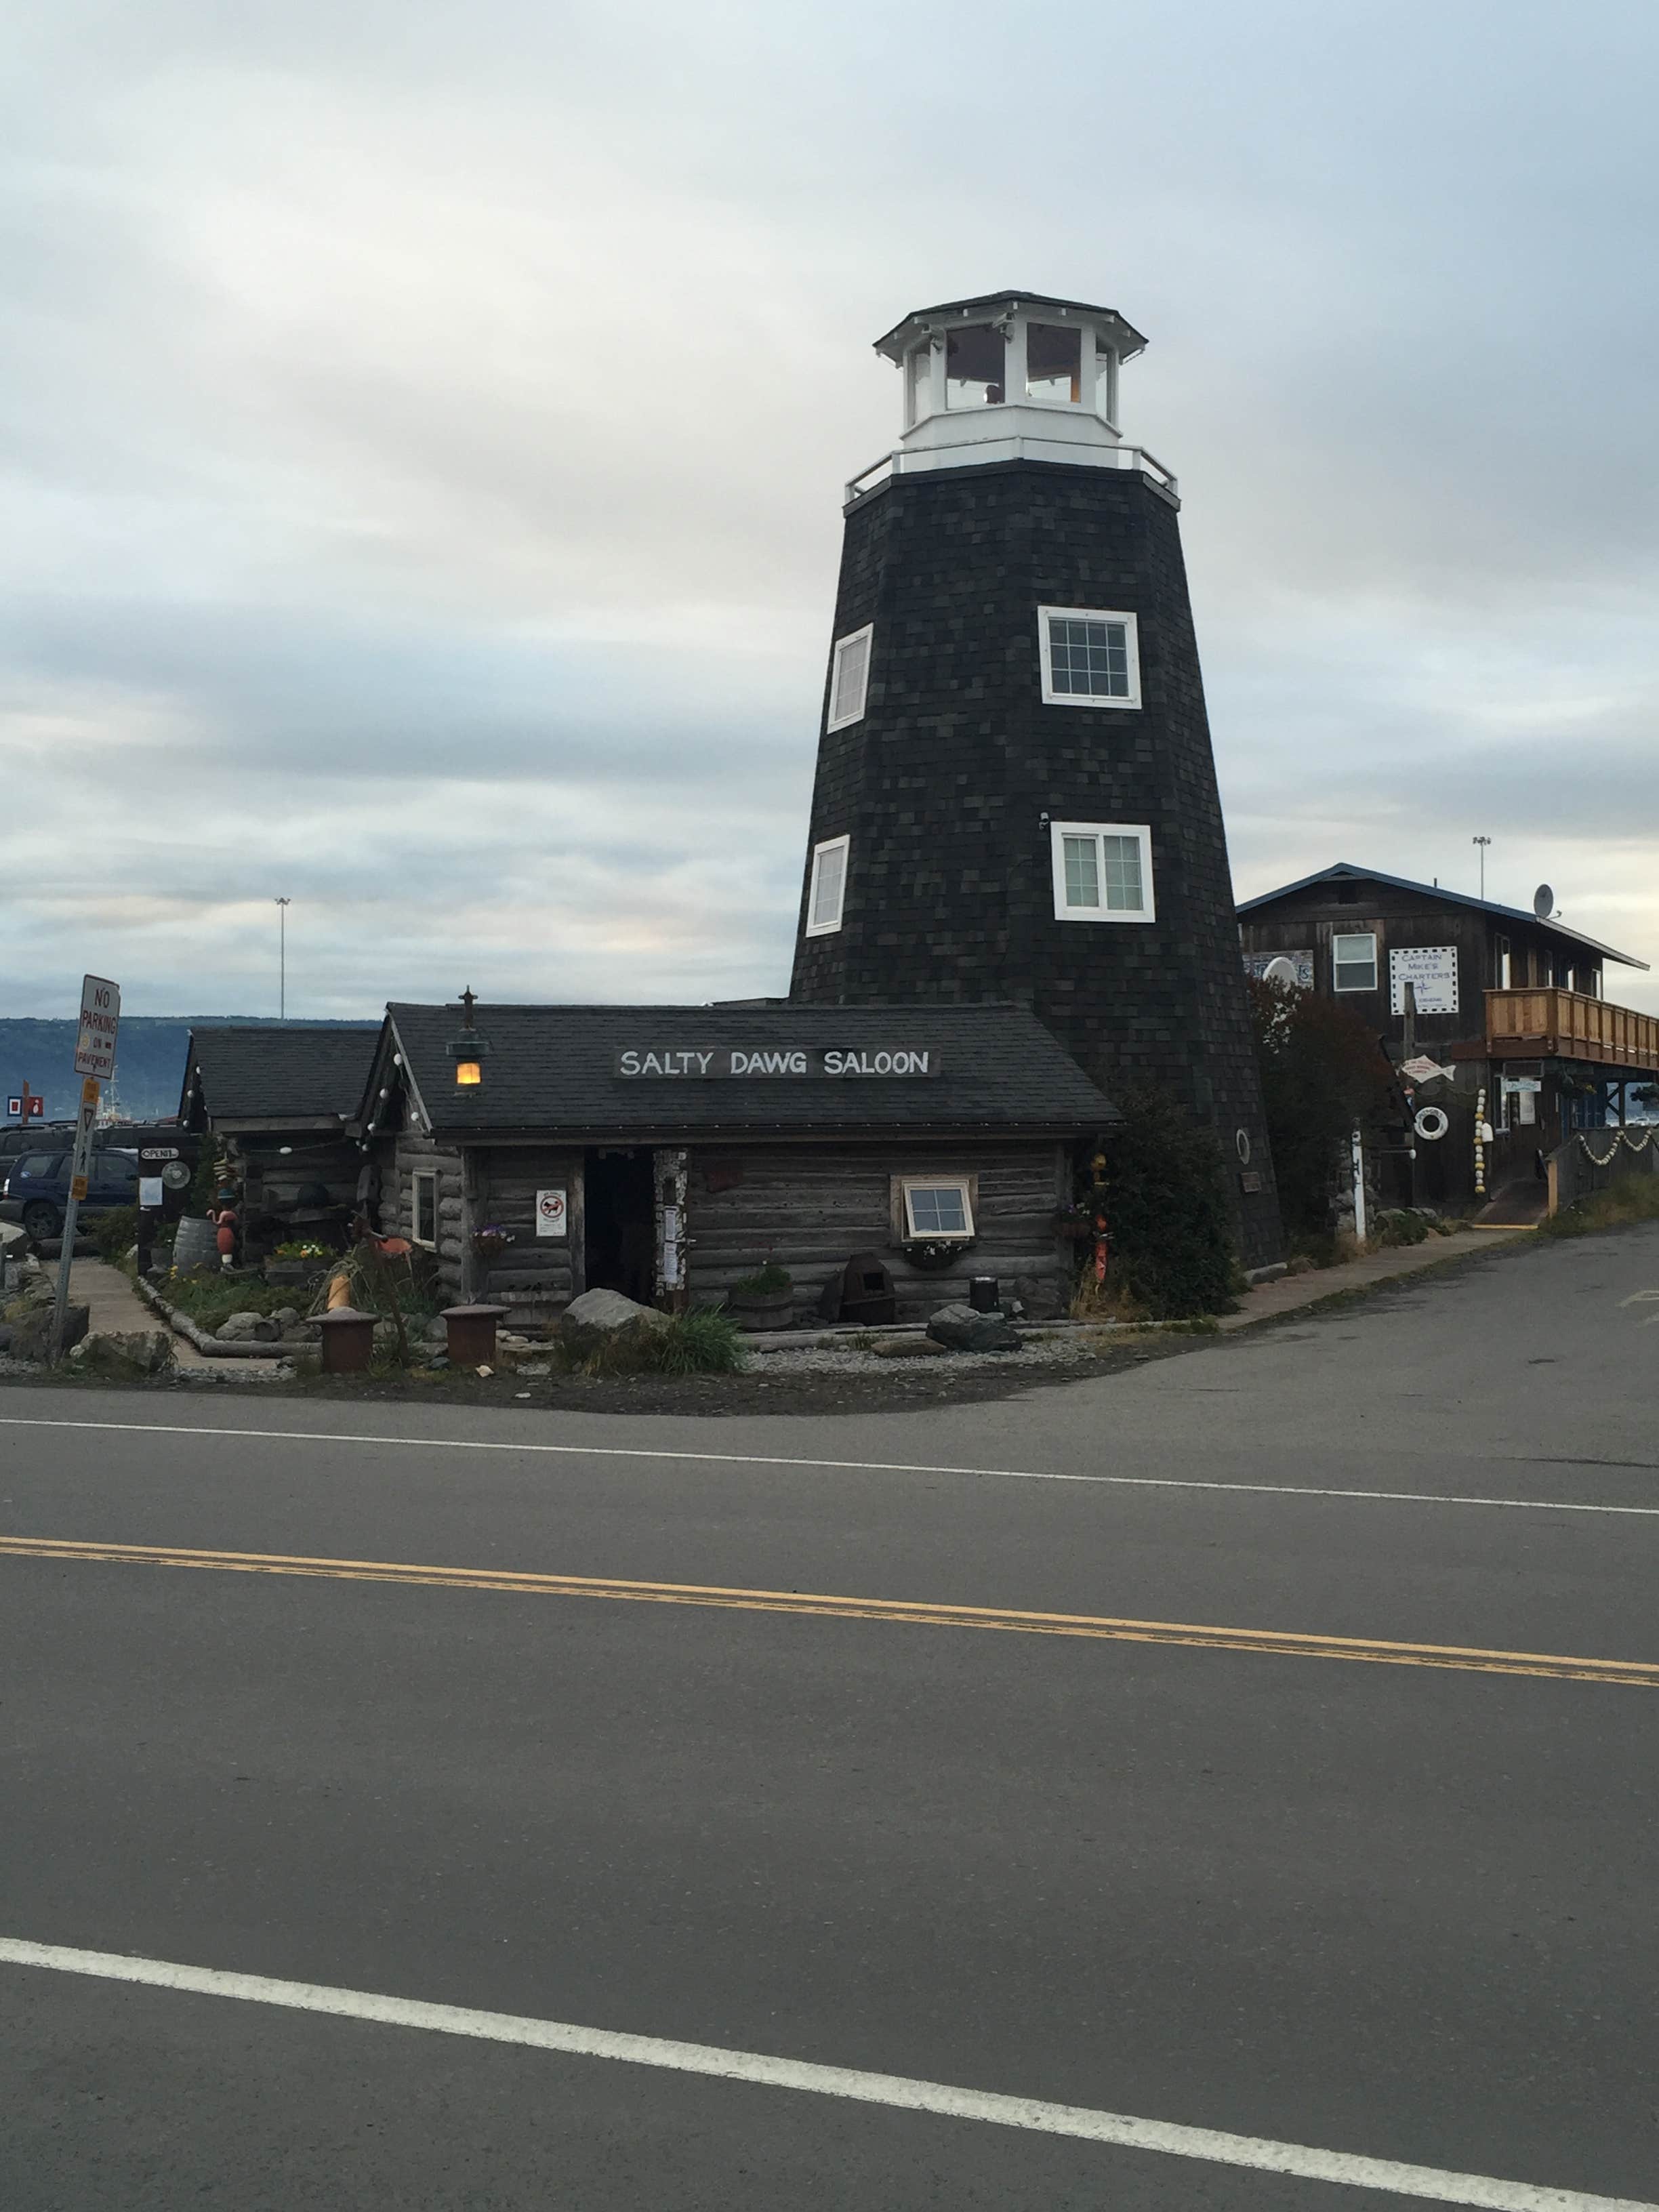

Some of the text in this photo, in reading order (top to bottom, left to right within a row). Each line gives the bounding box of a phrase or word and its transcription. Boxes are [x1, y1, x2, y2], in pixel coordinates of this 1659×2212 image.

[1398, 972, 1450, 981] CHARTERS
[94, 988, 110, 1008] NO
[81, 1010, 117, 1034] PARKING
[93, 1037, 102, 1048] ON
[77, 1051, 111, 1069] PAVEMENT
[620, 1050, 929, 1076] SALTY DAWG SALOON
